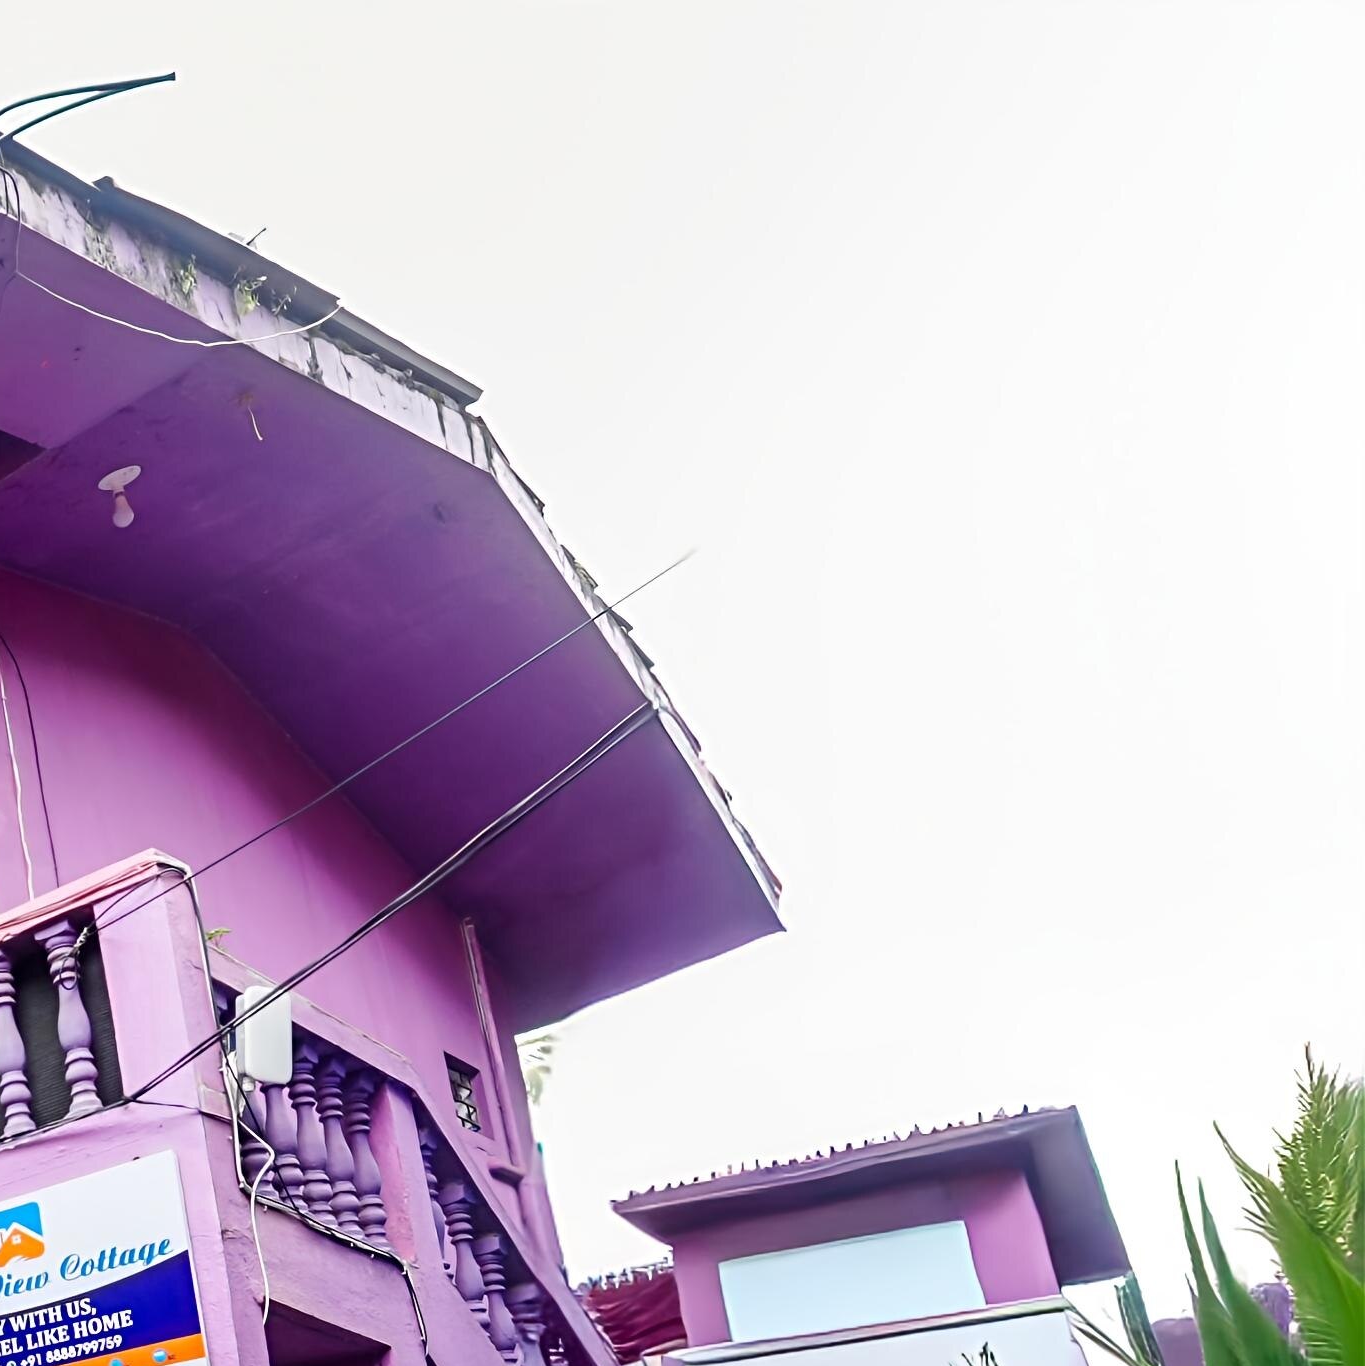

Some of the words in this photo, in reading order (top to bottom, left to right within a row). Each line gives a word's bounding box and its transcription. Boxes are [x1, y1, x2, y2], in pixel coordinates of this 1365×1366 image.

[60, 1239, 173, 1281] Cottage
[9, 1305, 62, 1332] WITH
[65, 1298, 96, 1319] US,
[26, 1325, 70, 1350] LIKE
[73, 1310, 134, 1339] HOME
